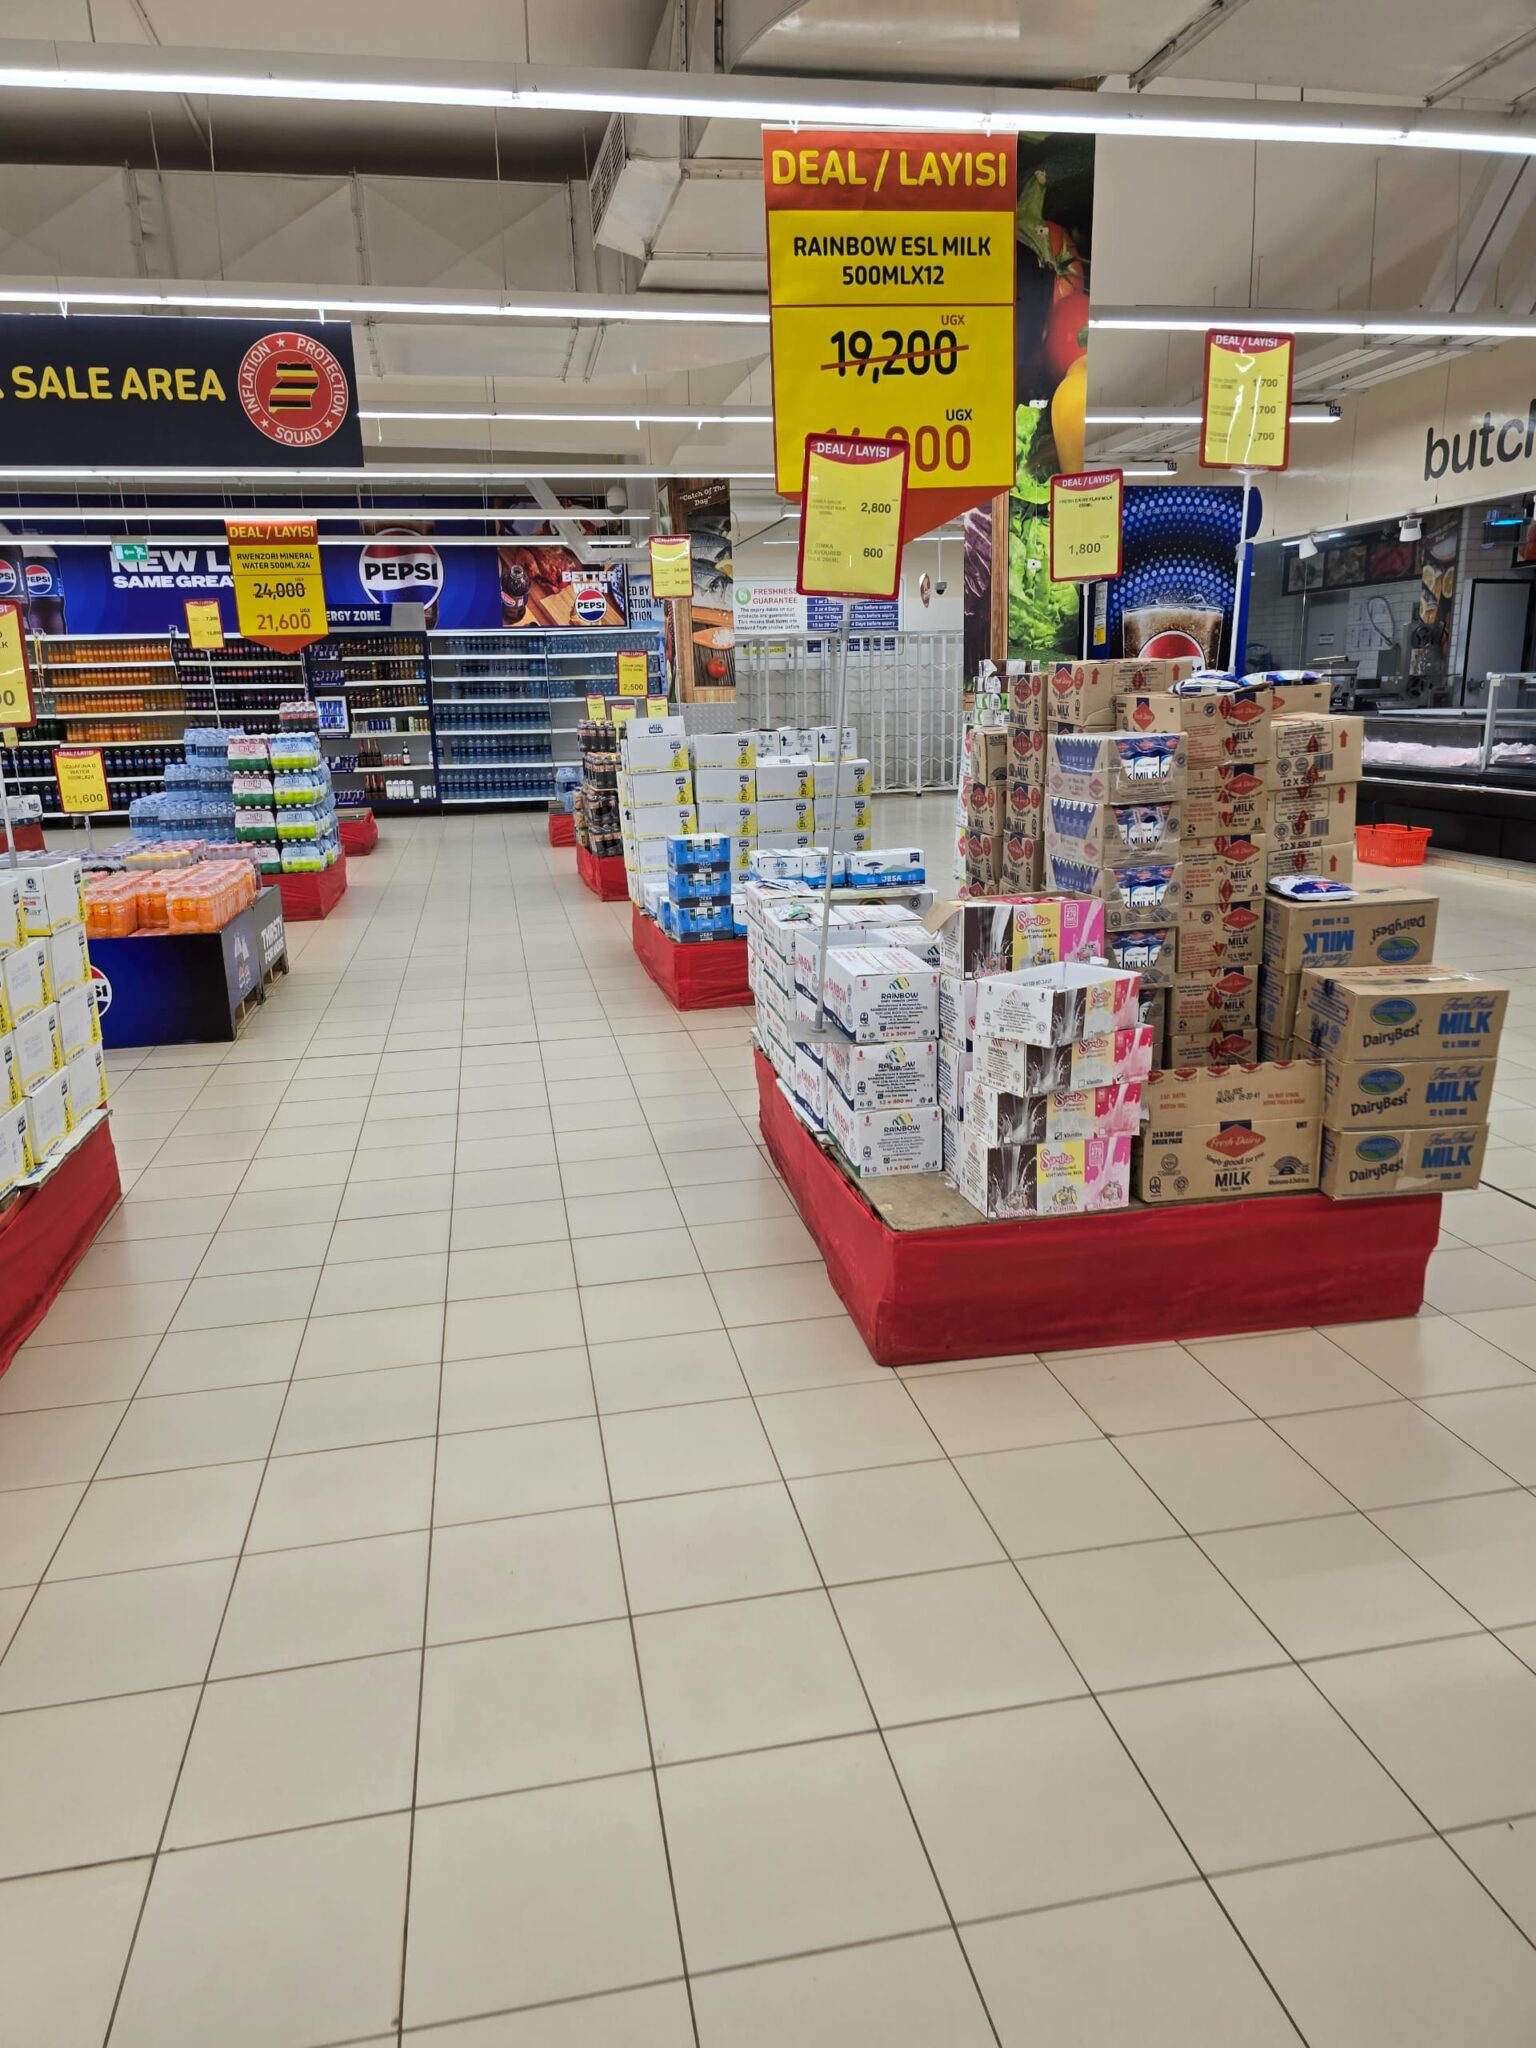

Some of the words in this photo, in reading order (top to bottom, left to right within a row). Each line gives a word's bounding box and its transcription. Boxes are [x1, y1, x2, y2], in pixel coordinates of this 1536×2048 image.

[771, 150, 867, 186] DEAL
[873, 150, 890, 192] /
[900, 152, 1007, 188] LAYISI
[793, 236, 896, 257] RAINBOW
[901, 236, 938, 257] ESL
[942, 236, 991, 257] MILK
[842, 265, 945, 286] 500MLX12
[940, 314, 965, 326] UGX
[1215, 335, 1240, 346] DEAL
[1248, 337, 1278, 348] LAYISI
[830, 330, 957, 383] 19,200
[11, 365, 113, 400] SALE
[121, 368, 226, 401] AREA
[241, 342, 271, 415] INFLATION
[297, 338, 345, 417] PROTECTION
[945, 409, 973, 422] UGX
[275, 426, 322, 445] SQUAD
[1248, 432, 1275, 442] ,700
[816, 442, 846, 456] DEAL
[856, 445, 890, 458] LAYISI
[1062, 478, 1083, 488] DEAL
[1089, 475, 1114, 485] LAYISI
[861, 502, 892, 515] 2,800
[229, 527, 263, 538] DEAL
[275, 526, 314, 538] LAYISI
[863, 548, 883, 559] 600
[1068, 542, 1101, 556] 1,800
[110, 550, 197, 573] NEW
[0, 572, 14, 581] PSI
[365, 563, 438, 581] PEPSI
[561, 571, 616, 582] BETTER
[113, 575, 175, 588] SAME
[253, 583, 306, 600] 24,000
[639, 586, 649, 596] BY
[752, 597, 798, 605] GUARANTEE
[256, 614, 311, 631] 21,600
[326, 611, 351, 620] ERGY
[353, 611, 381, 620] ZONE
[1232, 731, 1254, 740] MILK
[1136, 771, 1158, 780] MILK
[65, 793, 104, 805] 21,600
[1233, 803, 1255, 812] MILK
[1280, 842, 1289, 850] 12
[1230, 870, 1252, 879] MILK
[1132, 899, 1154, 908] MILK
[1016, 911, 1050, 932] Simka
[1371, 915, 1426, 940] DairyBest
[1228, 937, 1249, 945] MILK
[1302, 930, 1356, 954] MILK
[1125, 960, 1148, 969] MILK
[1224, 1001, 1245, 1009] MILK
[1438, 1011, 1493, 1034] MILK
[1363, 1022, 1420, 1048] DairyBest
[1425, 1081, 1480, 1103] MILK
[1054, 1093, 1088, 1107] Simka
[1351, 1092, 1408, 1116] DairyBest
[884, 1125, 920, 1133] RAINBOW
[1210, 1135, 1233, 1148] Fresh
[1235, 1134, 1261, 1146] Dairy
[1040, 1149, 1075, 1171] Simka
[1223, 1159, 1244, 1167] good
[1421, 1145, 1473, 1168] MILK
[1349, 1159, 1404, 1182] DairyBest
[1215, 1171, 1251, 1187] MILK
